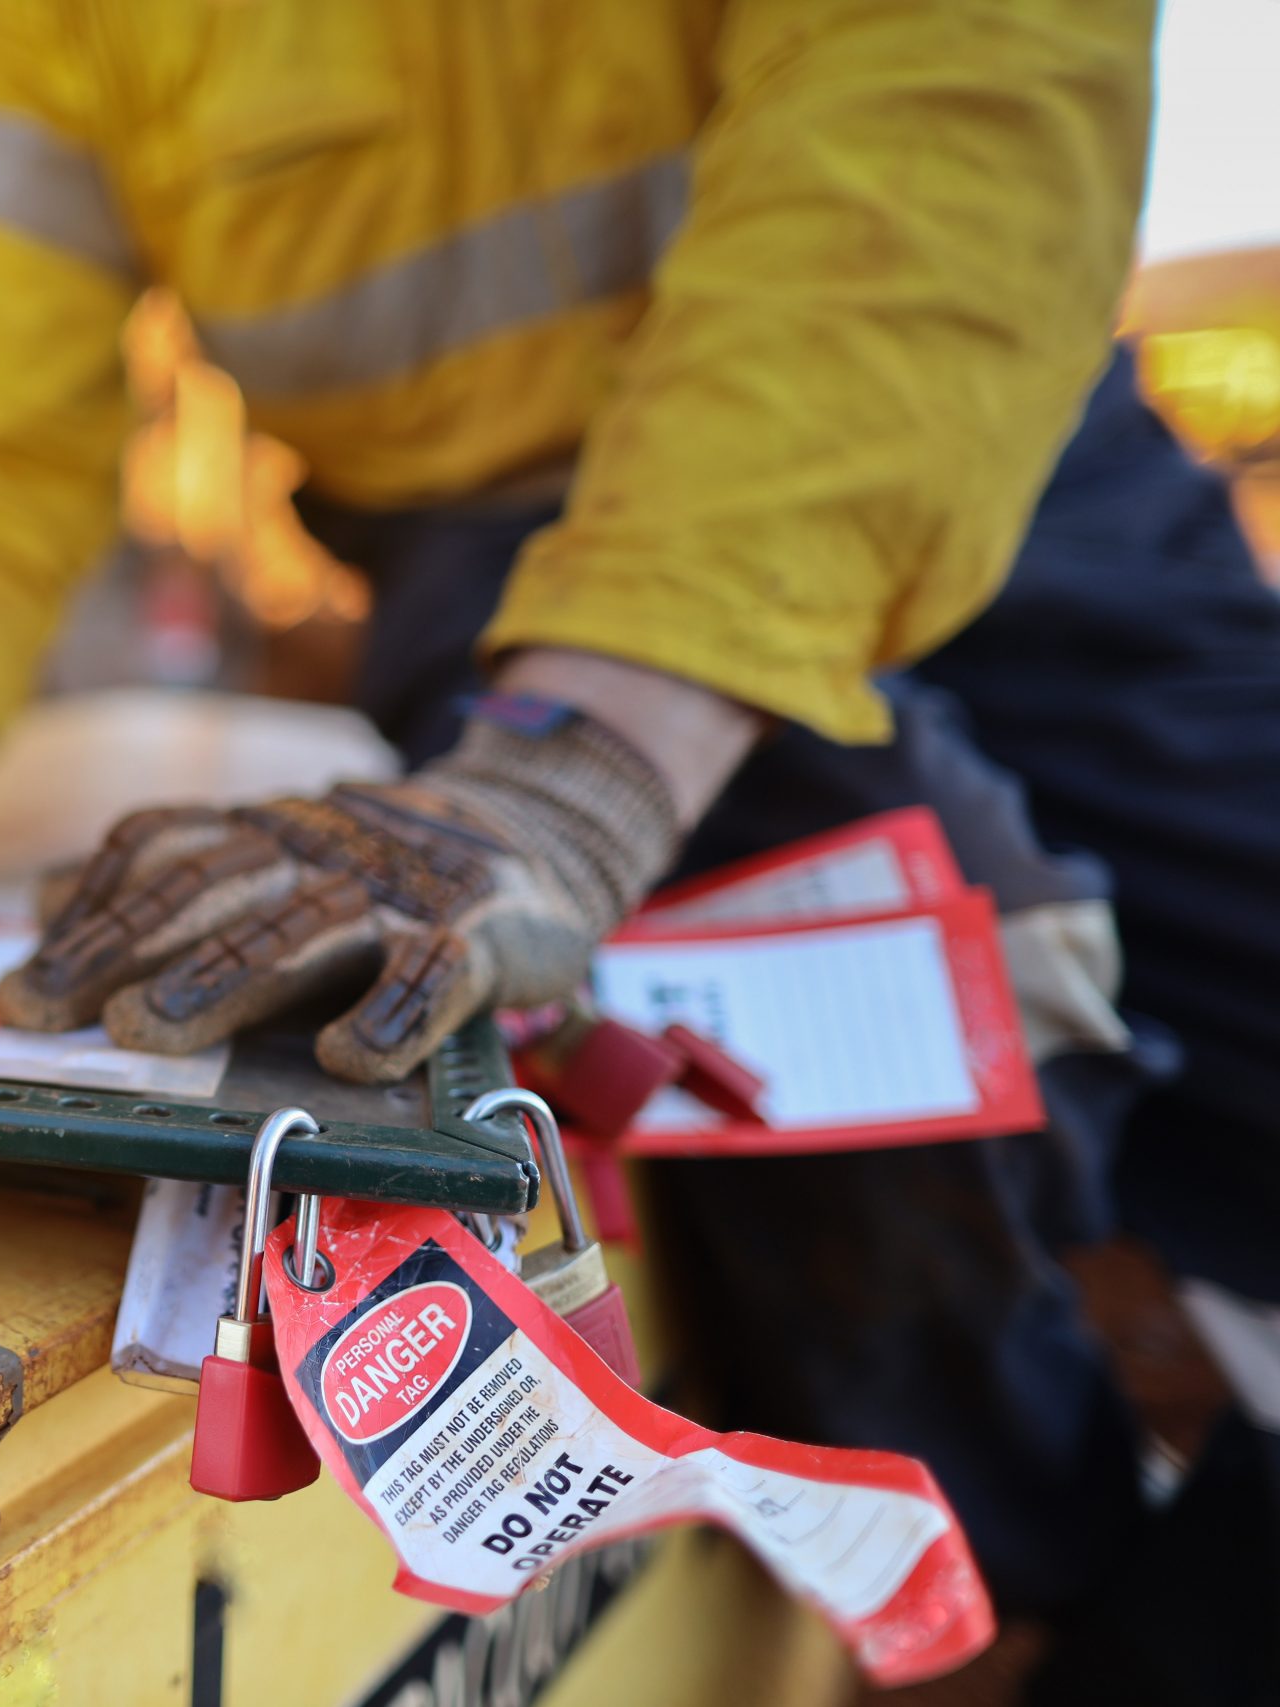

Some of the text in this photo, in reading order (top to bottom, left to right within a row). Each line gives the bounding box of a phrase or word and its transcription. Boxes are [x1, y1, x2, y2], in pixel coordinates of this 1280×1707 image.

[335, 1311, 405, 1376] PERSONAL
[335, 1303, 457, 1428] DANGER
[396, 1375, 430, 1405] TAG
[380, 1357, 523, 1506] THIS TAG MUST NOT BE REMOVED
[394, 1375, 542, 1527] EXCEPT BY THE UNDERSIGNED OR,
[429, 1405, 540, 1525] AS PROVIDED UNDER THE
[442, 1418, 559, 1544] DANGER TAG REGULATIONS
[481, 1452, 584, 1555] DO NOT
[512, 1464, 635, 1571] OPERATE
